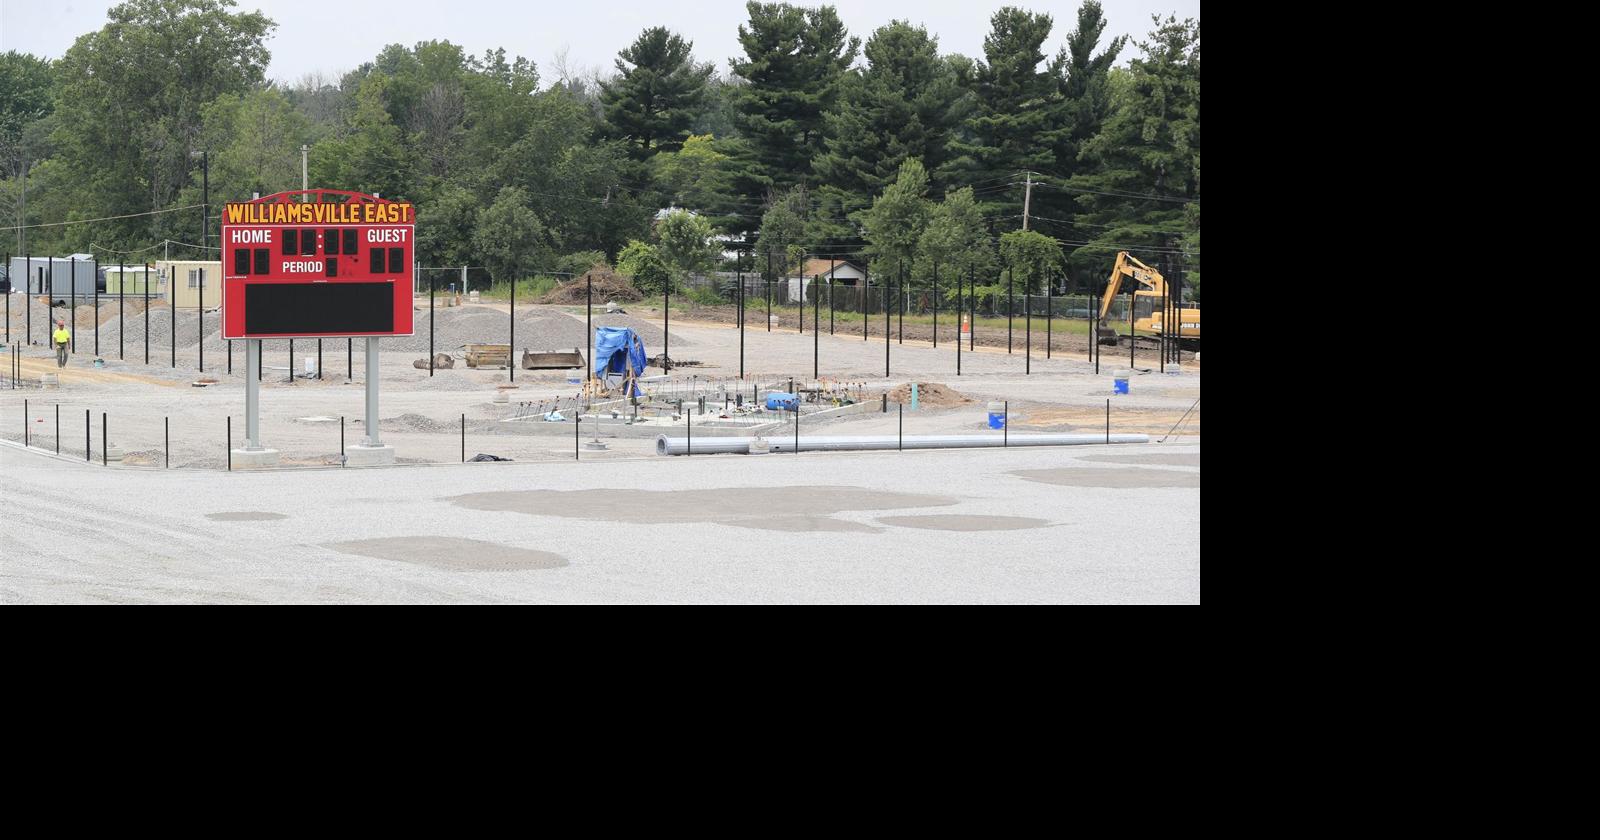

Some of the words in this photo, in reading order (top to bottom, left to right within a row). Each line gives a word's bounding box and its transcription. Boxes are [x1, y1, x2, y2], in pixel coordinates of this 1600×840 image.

[226, 203, 360, 223] WILLIAMSVILLE
[365, 203, 410, 223] EAST
[232, 229, 272, 243] HOME
[367, 229, 408, 243] GUEST
[282, 261, 323, 273] PERIOD
